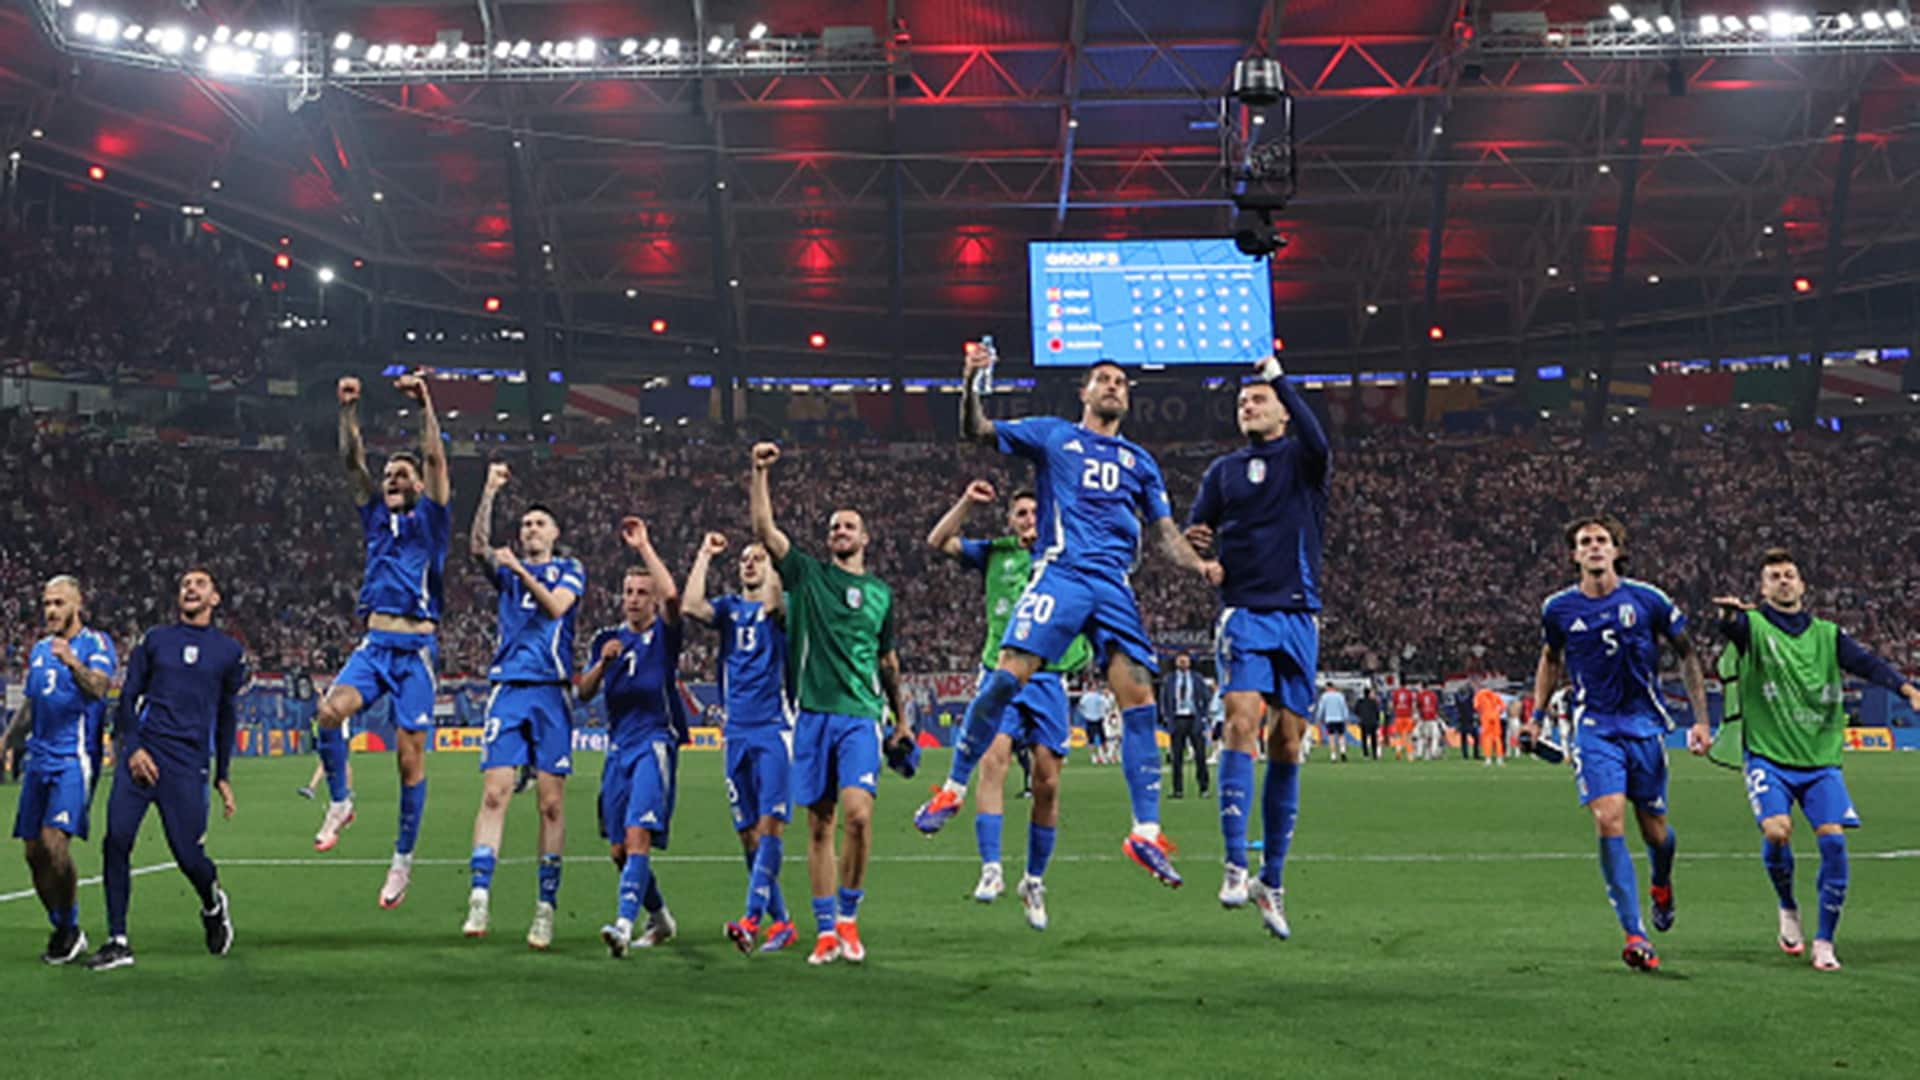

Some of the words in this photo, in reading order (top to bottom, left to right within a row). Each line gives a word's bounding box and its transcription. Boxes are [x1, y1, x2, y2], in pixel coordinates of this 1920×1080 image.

[1082, 458, 1119, 492] 20
[1017, 593, 1056, 624] 20
[737, 626, 757, 651] 13
[1602, 629, 1618, 656] 5
[42, 668, 57, 696] 3
